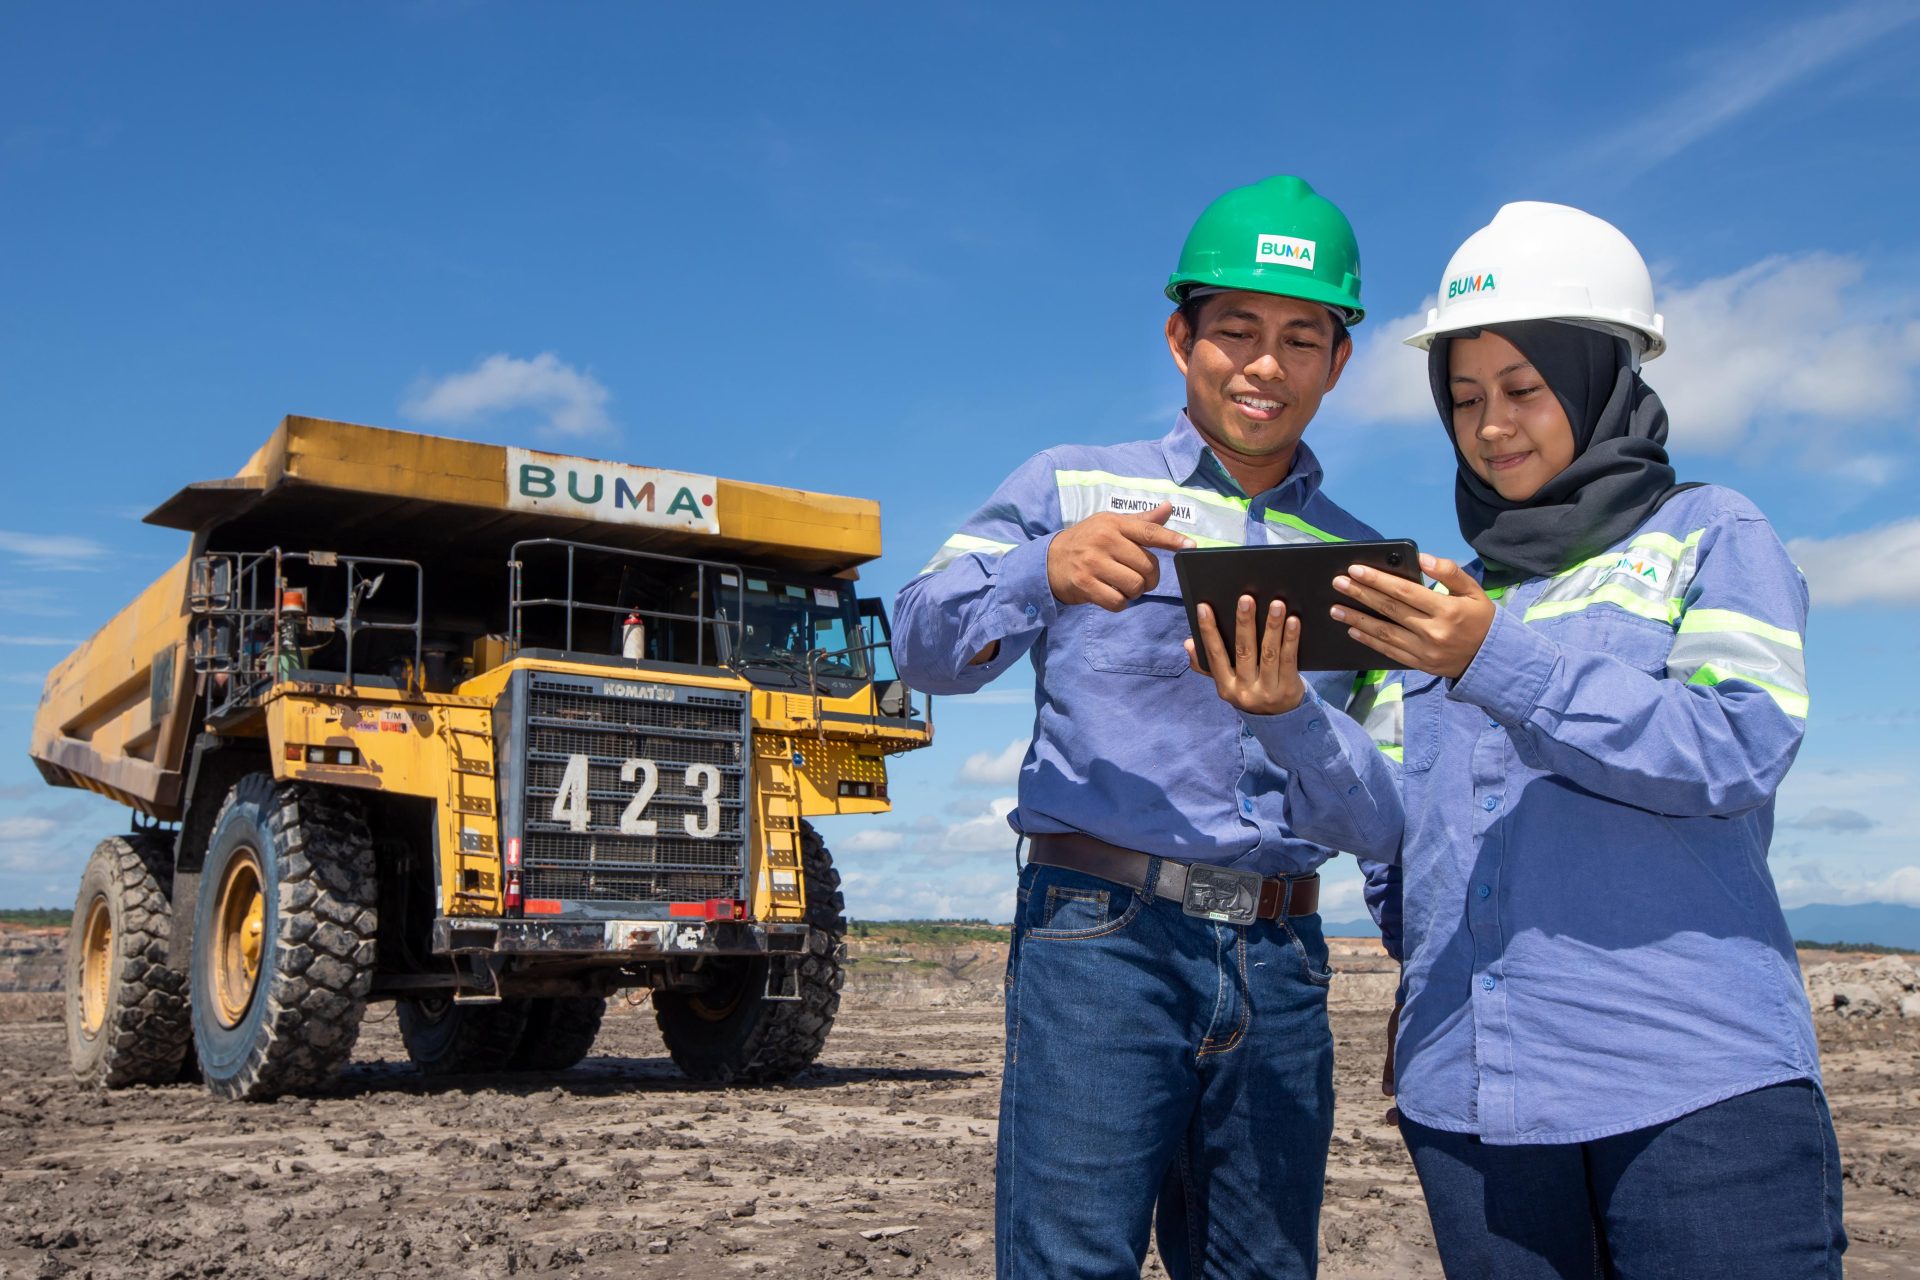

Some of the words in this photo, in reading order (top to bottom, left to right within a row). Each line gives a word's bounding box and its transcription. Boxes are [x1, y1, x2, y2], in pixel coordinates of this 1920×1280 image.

[1261, 242, 1311, 261] BUMA
[1448, 273, 1495, 298] BUMA
[519, 464, 703, 519] BUMA
[1111, 496, 1147, 511] HERYANTO
[604, 683, 675, 701] KOMATSU
[385, 711, 402, 720] T/M
